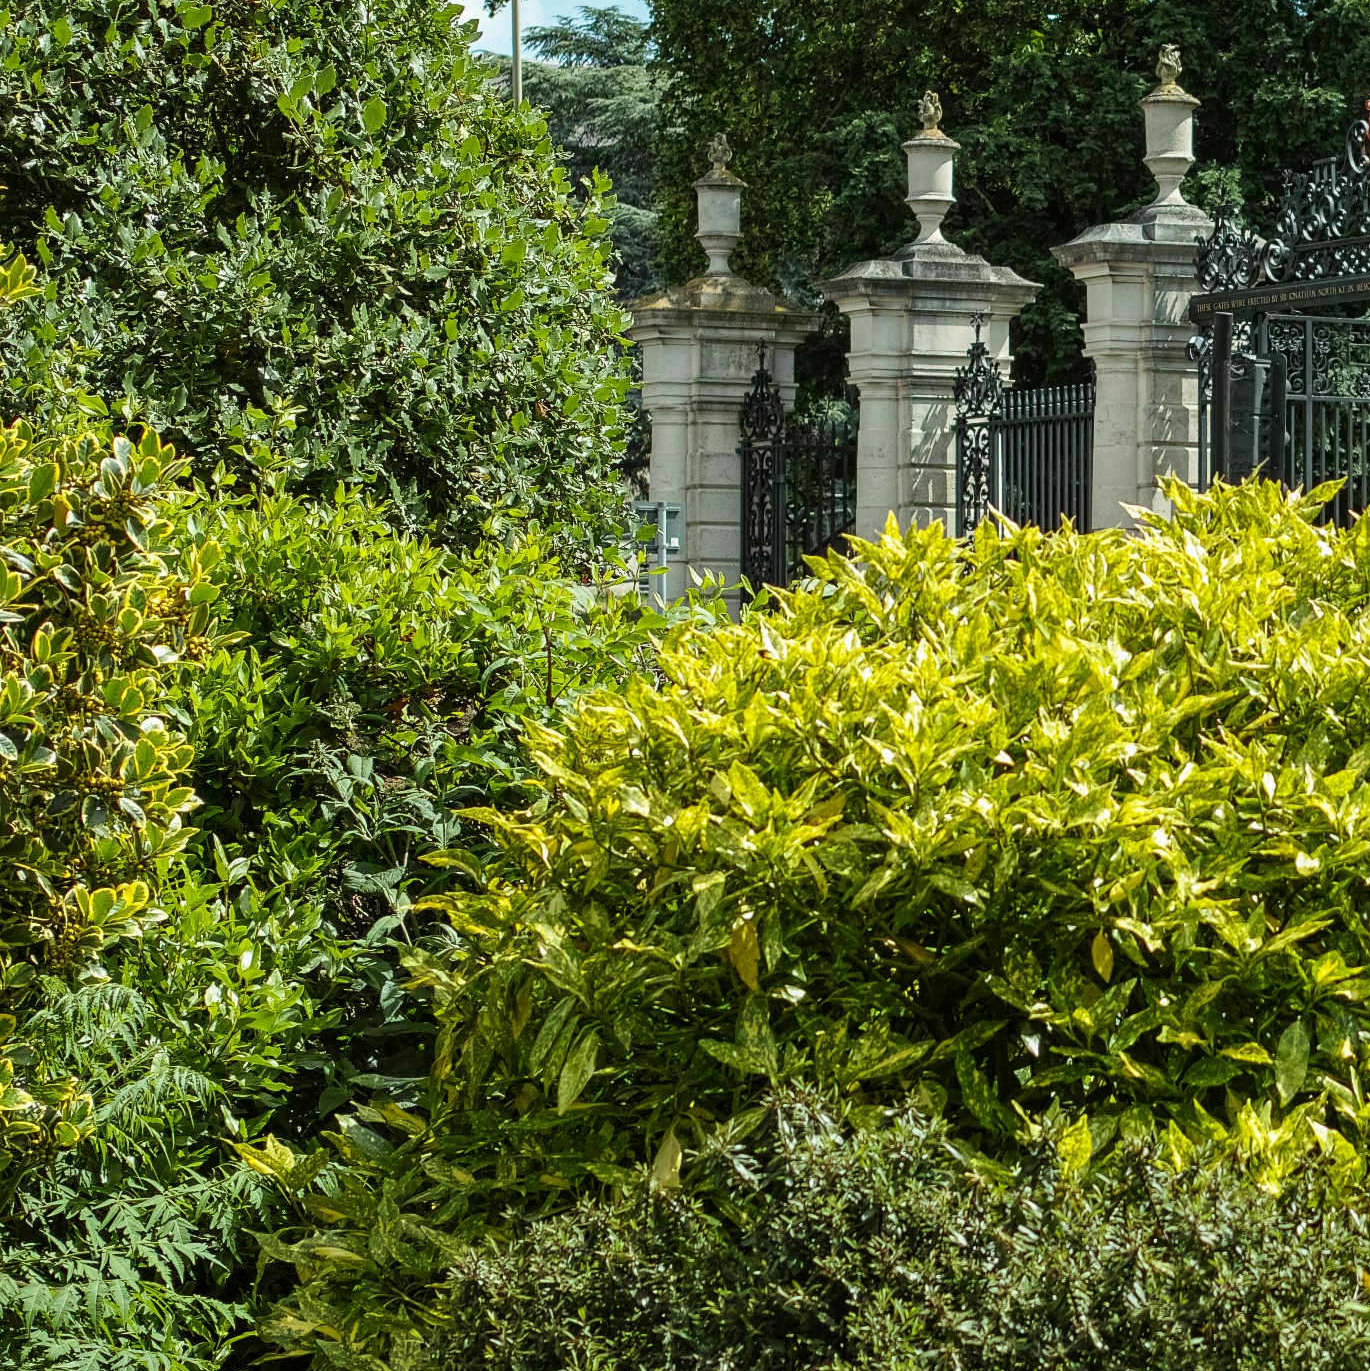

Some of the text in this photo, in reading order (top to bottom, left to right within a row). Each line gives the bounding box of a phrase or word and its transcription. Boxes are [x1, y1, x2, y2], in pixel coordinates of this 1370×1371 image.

[1197, 303, 1211, 313] THESE
[1213, 302, 1229, 310] GATES
[1231, 299, 1245, 307] WERE
[1247, 296, 1270, 306] ERECTED
[1271, 294, 1279, 303] BY
[1318, 286, 1336, 297] NORTH
